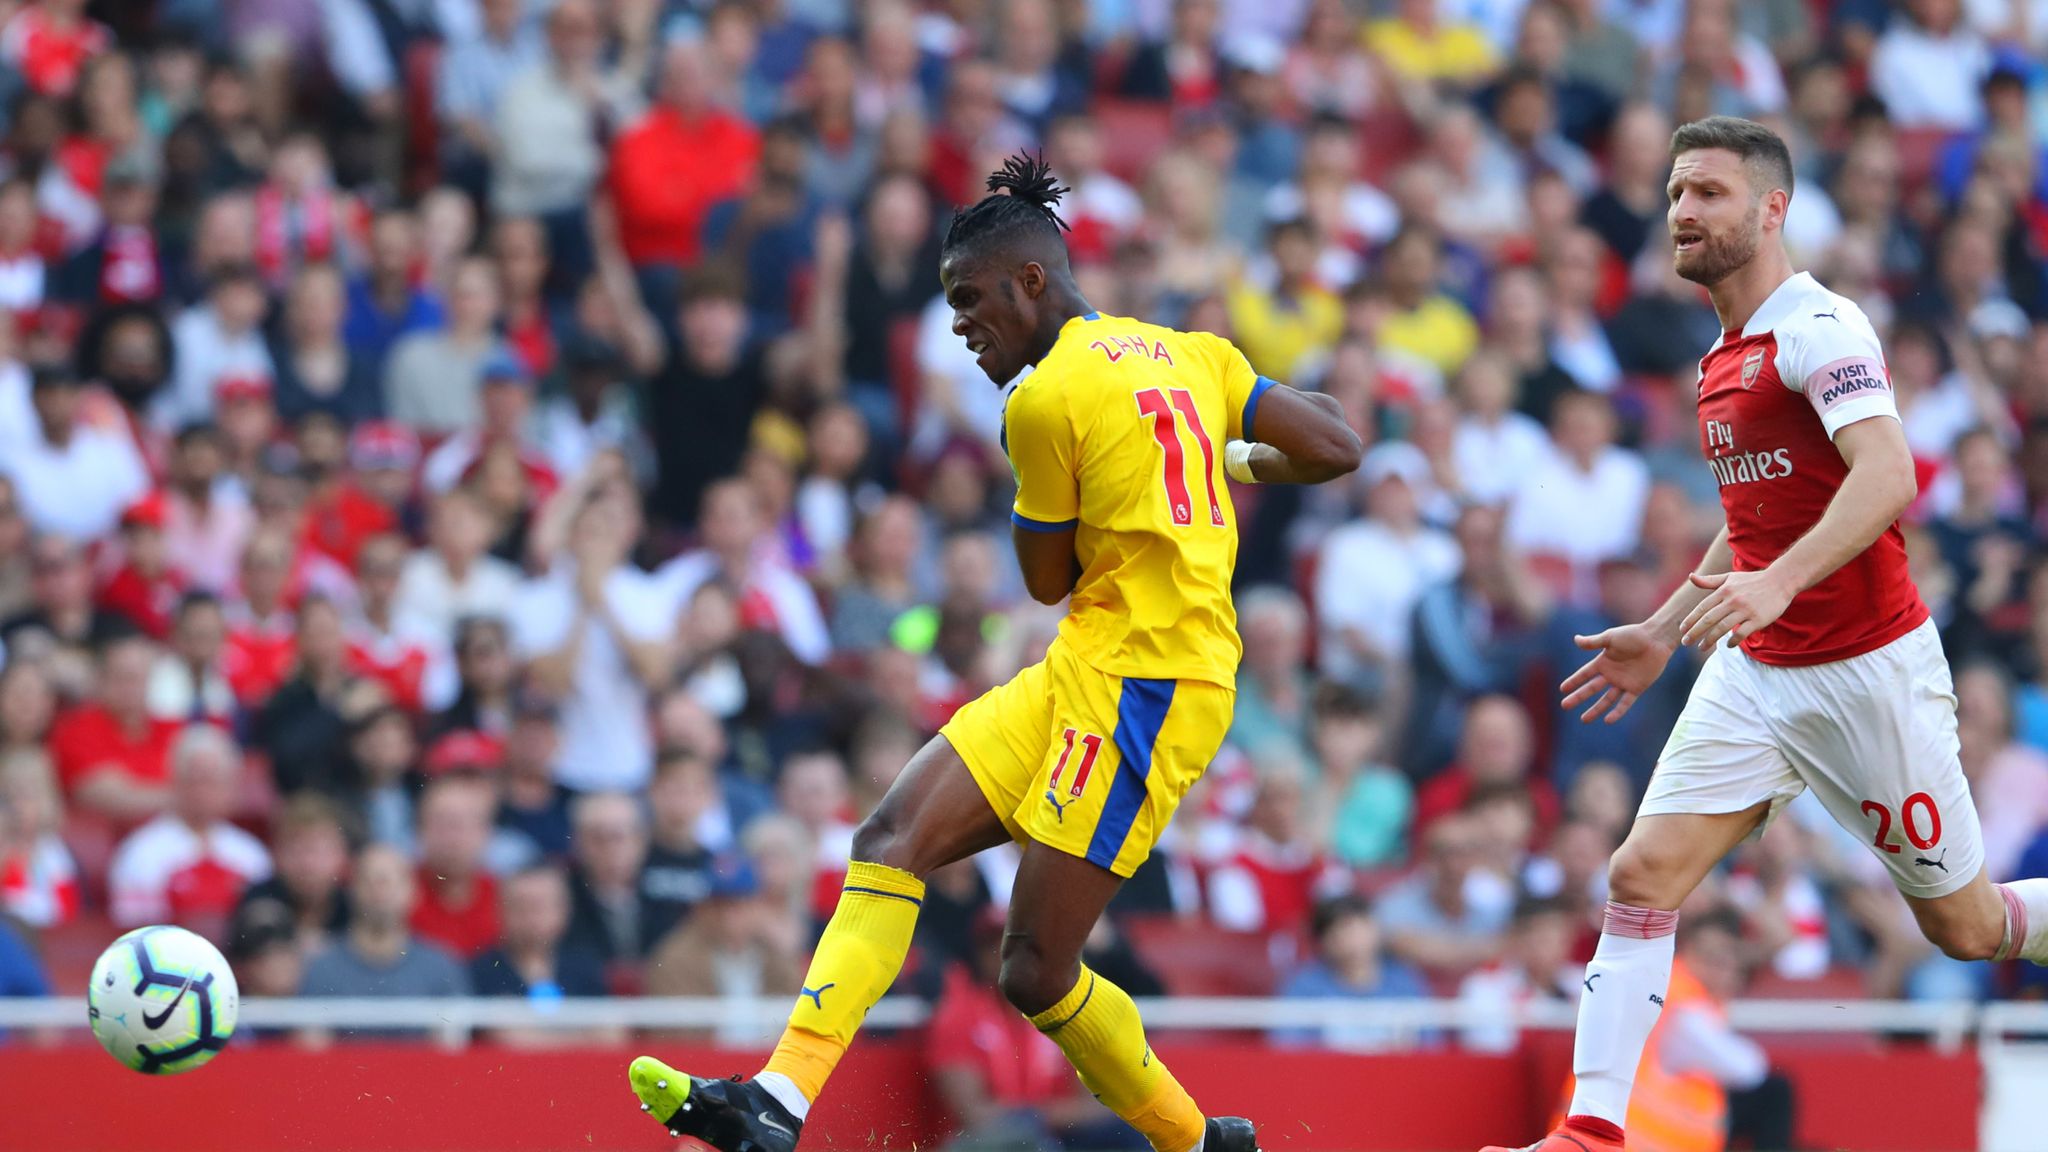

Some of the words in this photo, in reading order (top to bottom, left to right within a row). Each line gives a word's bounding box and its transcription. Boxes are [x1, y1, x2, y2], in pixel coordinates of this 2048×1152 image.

[1090, 335, 1175, 368] ZAHA
[1828, 364, 1869, 382] VISIT
[1821, 377, 1888, 406] RWANDA
[1706, 420, 1734, 449] Fly
[1134, 387, 1226, 527] 11
[1048, 727, 1104, 799] 11
[1860, 790, 1943, 855] 20
